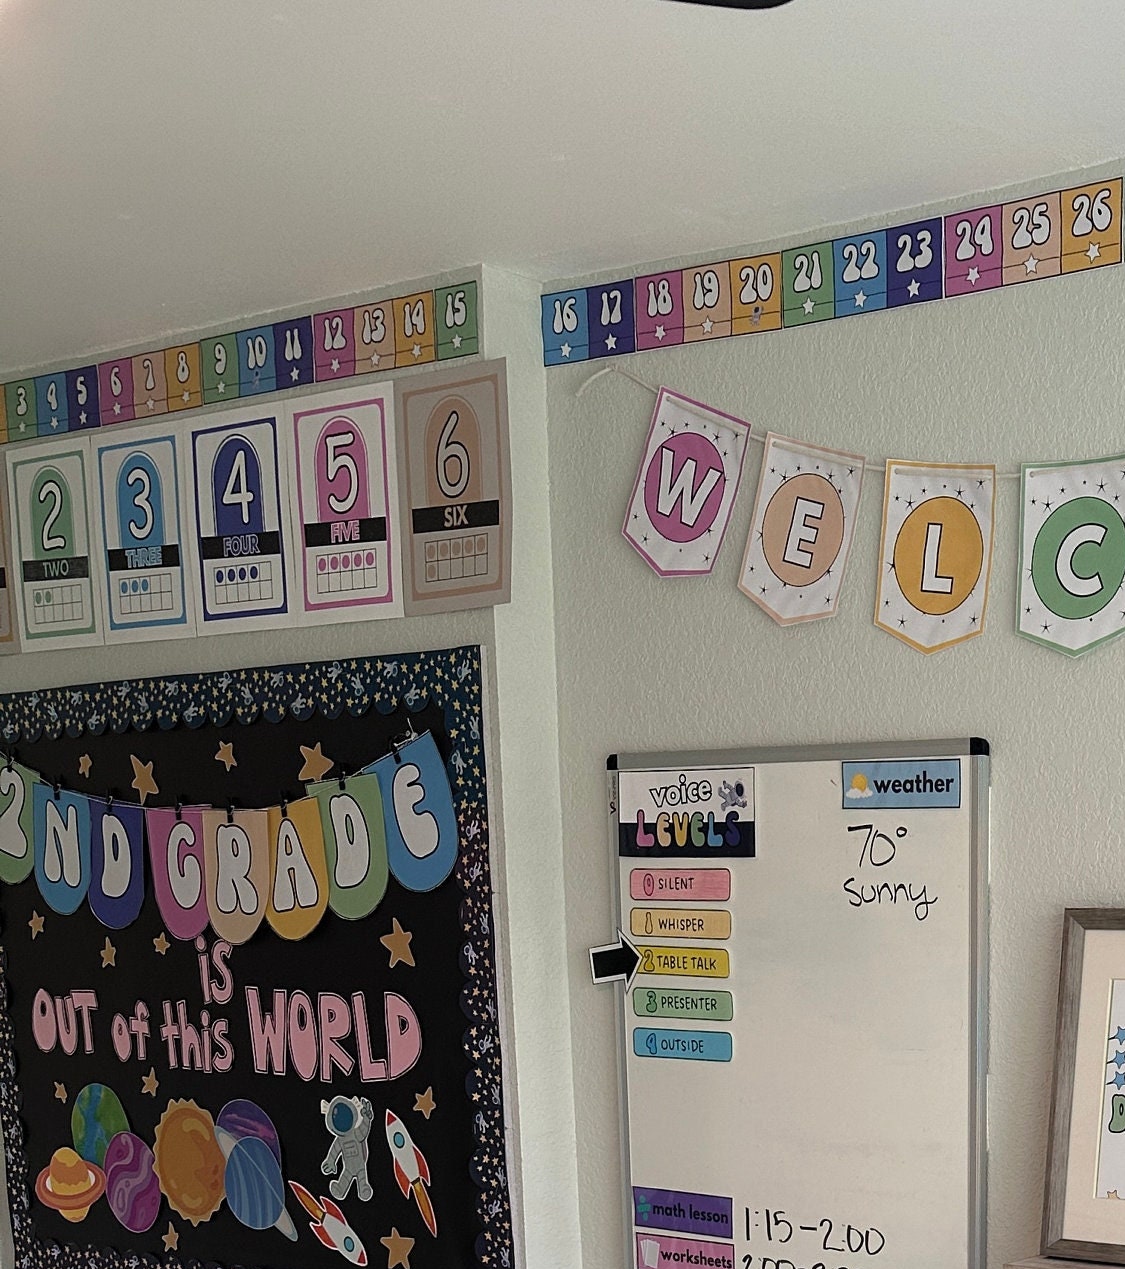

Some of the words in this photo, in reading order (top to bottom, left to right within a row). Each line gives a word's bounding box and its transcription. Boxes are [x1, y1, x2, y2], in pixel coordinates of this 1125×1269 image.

[553, 297, 578, 335] 16
[600, 288, 622, 326] 17
[646, 278, 674, 317] 18
[692, 269, 720, 309] 19
[739, 262, 774, 304] 20
[793, 251, 823, 293] 21
[841, 240, 880, 283] 22
[896, 230, 933, 272] 23
[955, 214, 994, 261] 24
[1011, 202, 1051, 249] 25
[1071, 189, 1113, 237] 26
[16, 386, 28, 416] 3
[47, 381, 58, 411] 4
[76, 376, 88, 406] 5
[110, 366, 123, 397] 6
[142, 358, 155, 391] 7
[176, 351, 190, 383] 8
[213, 342, 229, 375] 9
[246, 334, 268, 370] 10
[284, 328, 303, 361] 11
[323, 316, 347, 352] 12
[361, 307, 387, 346] 13
[403, 299, 426, 338] 14
[444, 290, 468, 328] 15
[435, 410, 471, 499] 6
[325, 430, 359, 515] 5
[222, 449, 254, 526] 4
[38, 480, 66, 551] 2
[125, 467, 154, 539] 3
[443, 506, 469, 528] SIX
[330, 521, 360, 543] FIVE
[125, 548, 163, 568] THREE
[223, 537, 260, 557] FOUR
[42, 561, 69, 577] TWO
[649, 774, 713, 808] voice
[873, 770, 955, 795] weather
[0, 766, 132, 898] 2ND
[166, 762, 440, 915] GRADE
[636, 809, 740, 848] LEVELS
[658, 877, 695, 891] SILENT
[658, 918, 704, 932] WHISPER
[196, 937, 233, 1006] is
[643, 949, 656, 972] 2
[656, 955, 688, 970] TABLE
[690, 957, 717, 971] TALK
[645, 991, 657, 1013] 3
[660, 996, 717, 1011] PRESENTER
[31, 988, 98, 1055] OUT
[110, 1000, 150, 1063] of
[162, 1000, 234, 1074] this
[244, 986, 423, 1083] WORLD
[661, 1038, 704, 1053] OUTSIDE
[652, 1203, 686, 1219] math
[688, 1208, 729, 1225] lesson
[660, 1249, 733, 1269] worksheets
